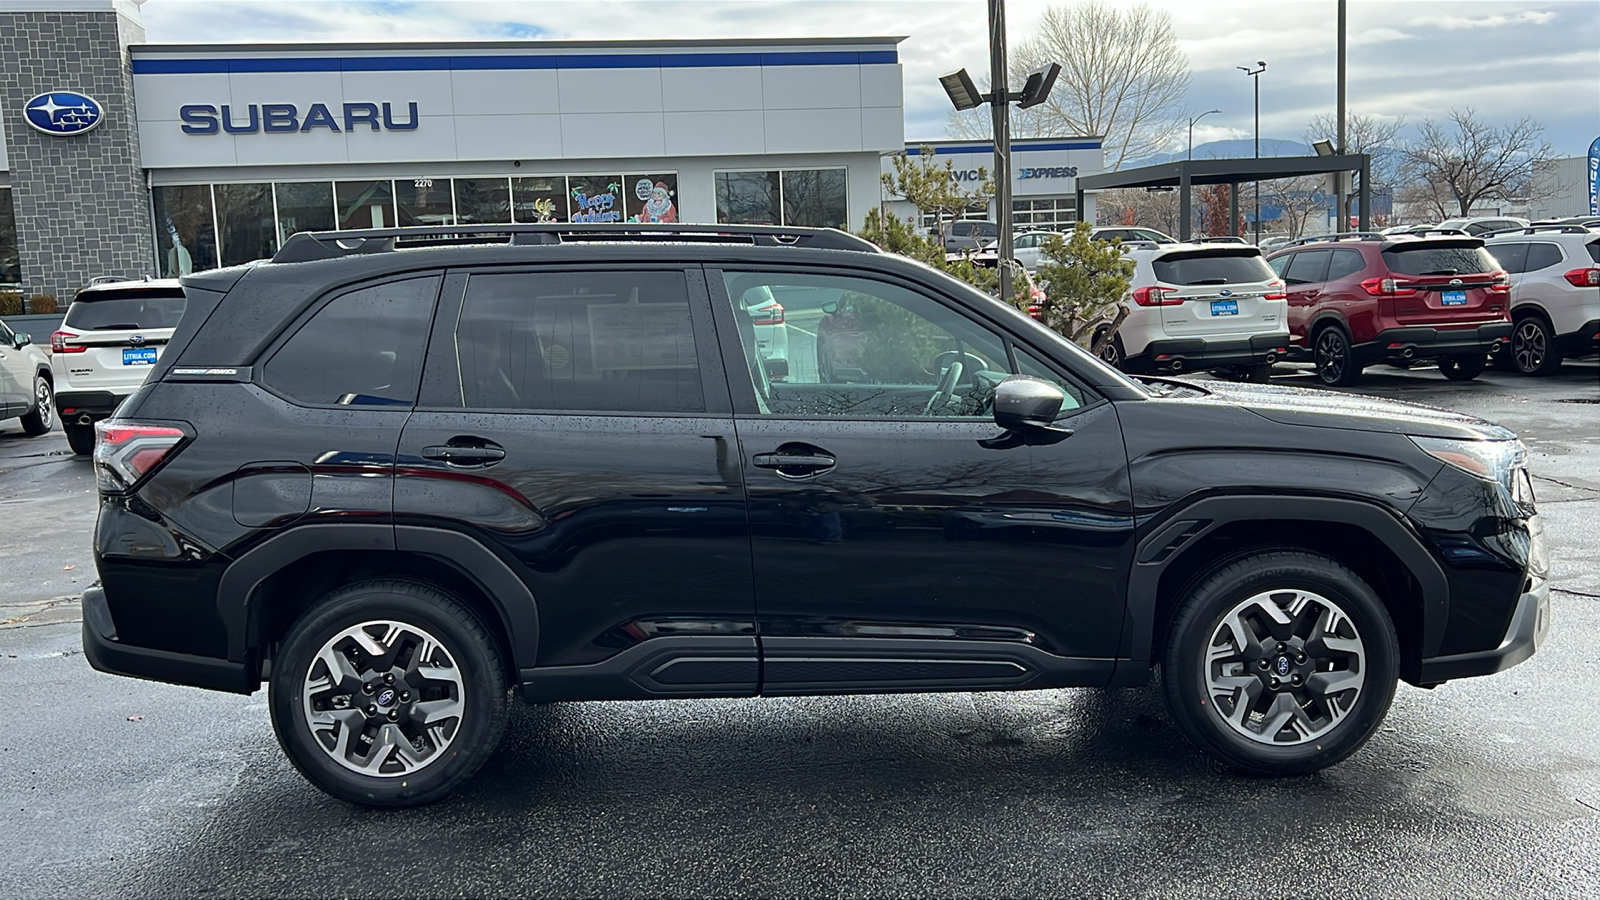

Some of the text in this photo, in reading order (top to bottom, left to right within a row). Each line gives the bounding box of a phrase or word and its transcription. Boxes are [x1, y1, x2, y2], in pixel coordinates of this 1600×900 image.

[180, 101, 419, 135] SUBARU
[1017, 166, 1078, 180] EXPRESS
[414, 179, 433, 188] 2270
[575, 193, 616, 211] Happy
[123, 352, 156, 361] LITHIA.COM
